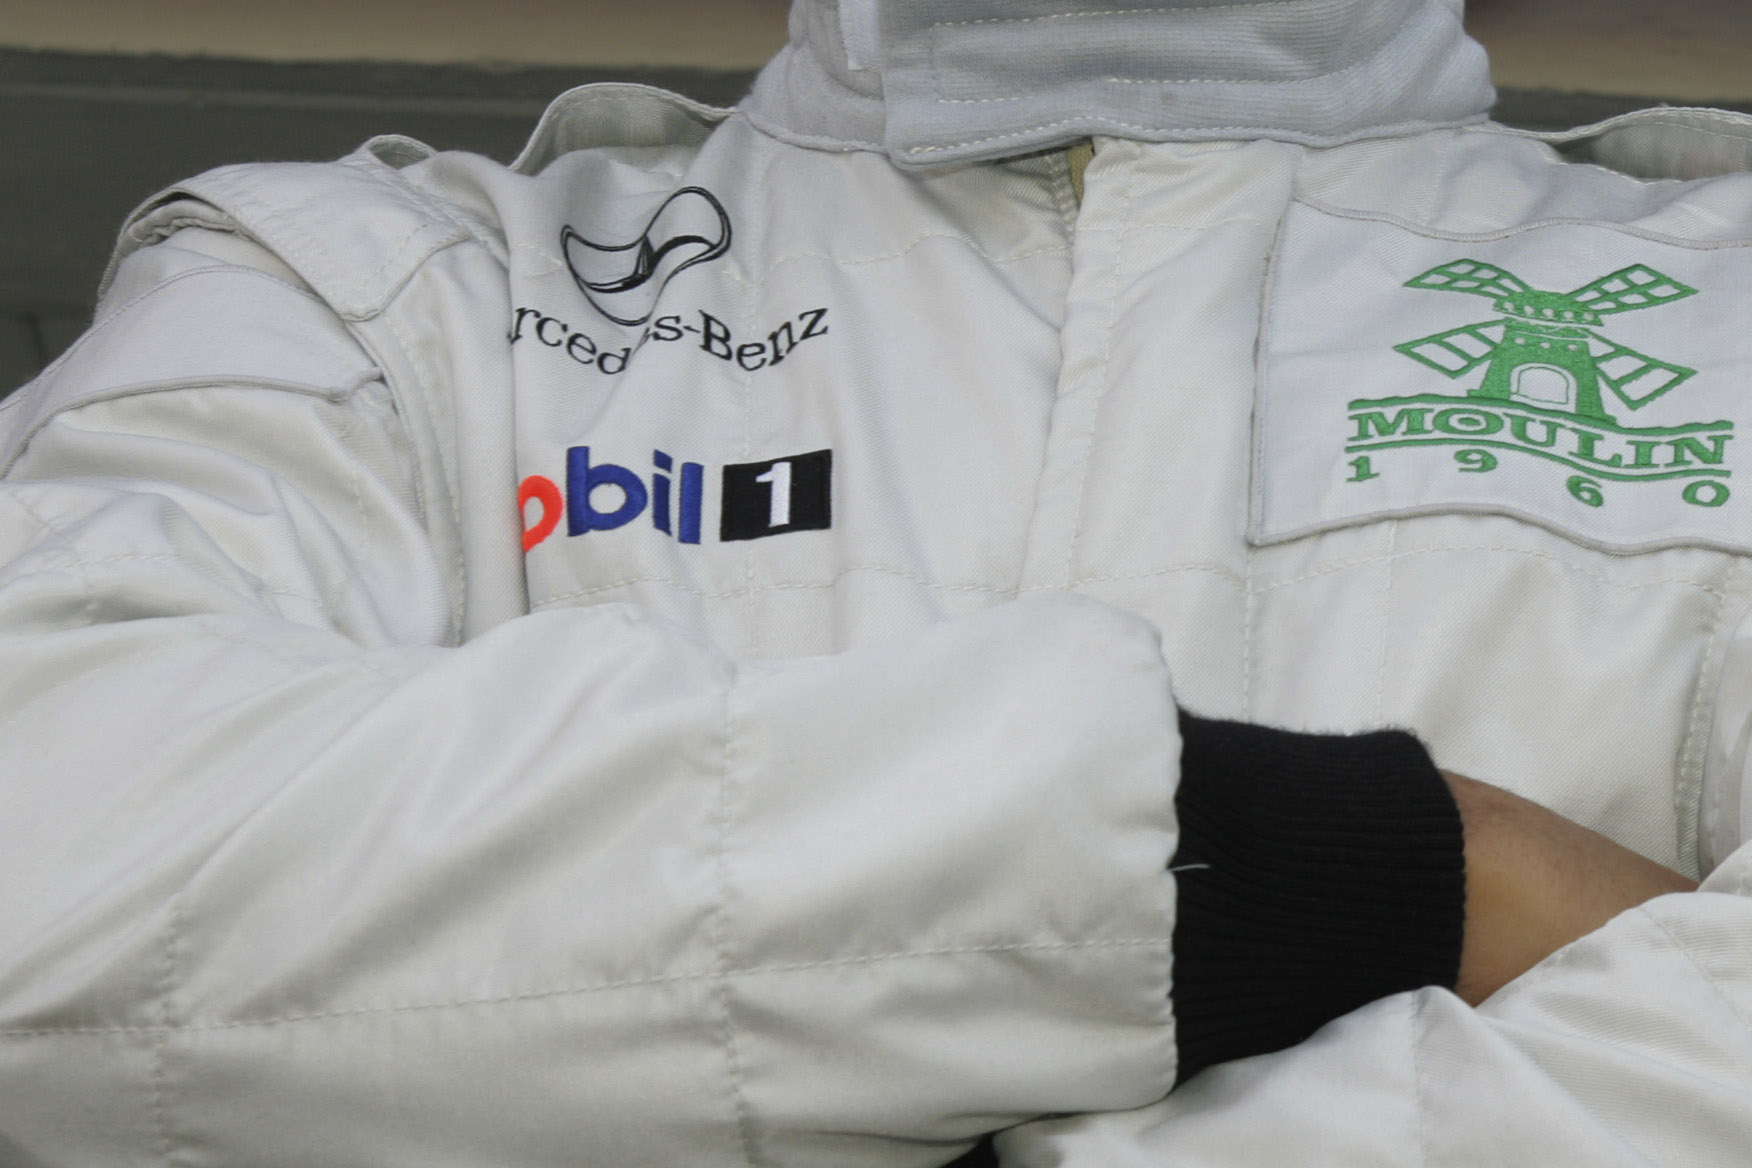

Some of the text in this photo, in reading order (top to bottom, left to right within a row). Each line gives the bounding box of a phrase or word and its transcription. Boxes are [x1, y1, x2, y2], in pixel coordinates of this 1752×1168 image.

[508, 307, 829, 375] rceds-Benz
[1345, 407, 1734, 470] MOULIN
[518, 446, 792, 553] obil 1
